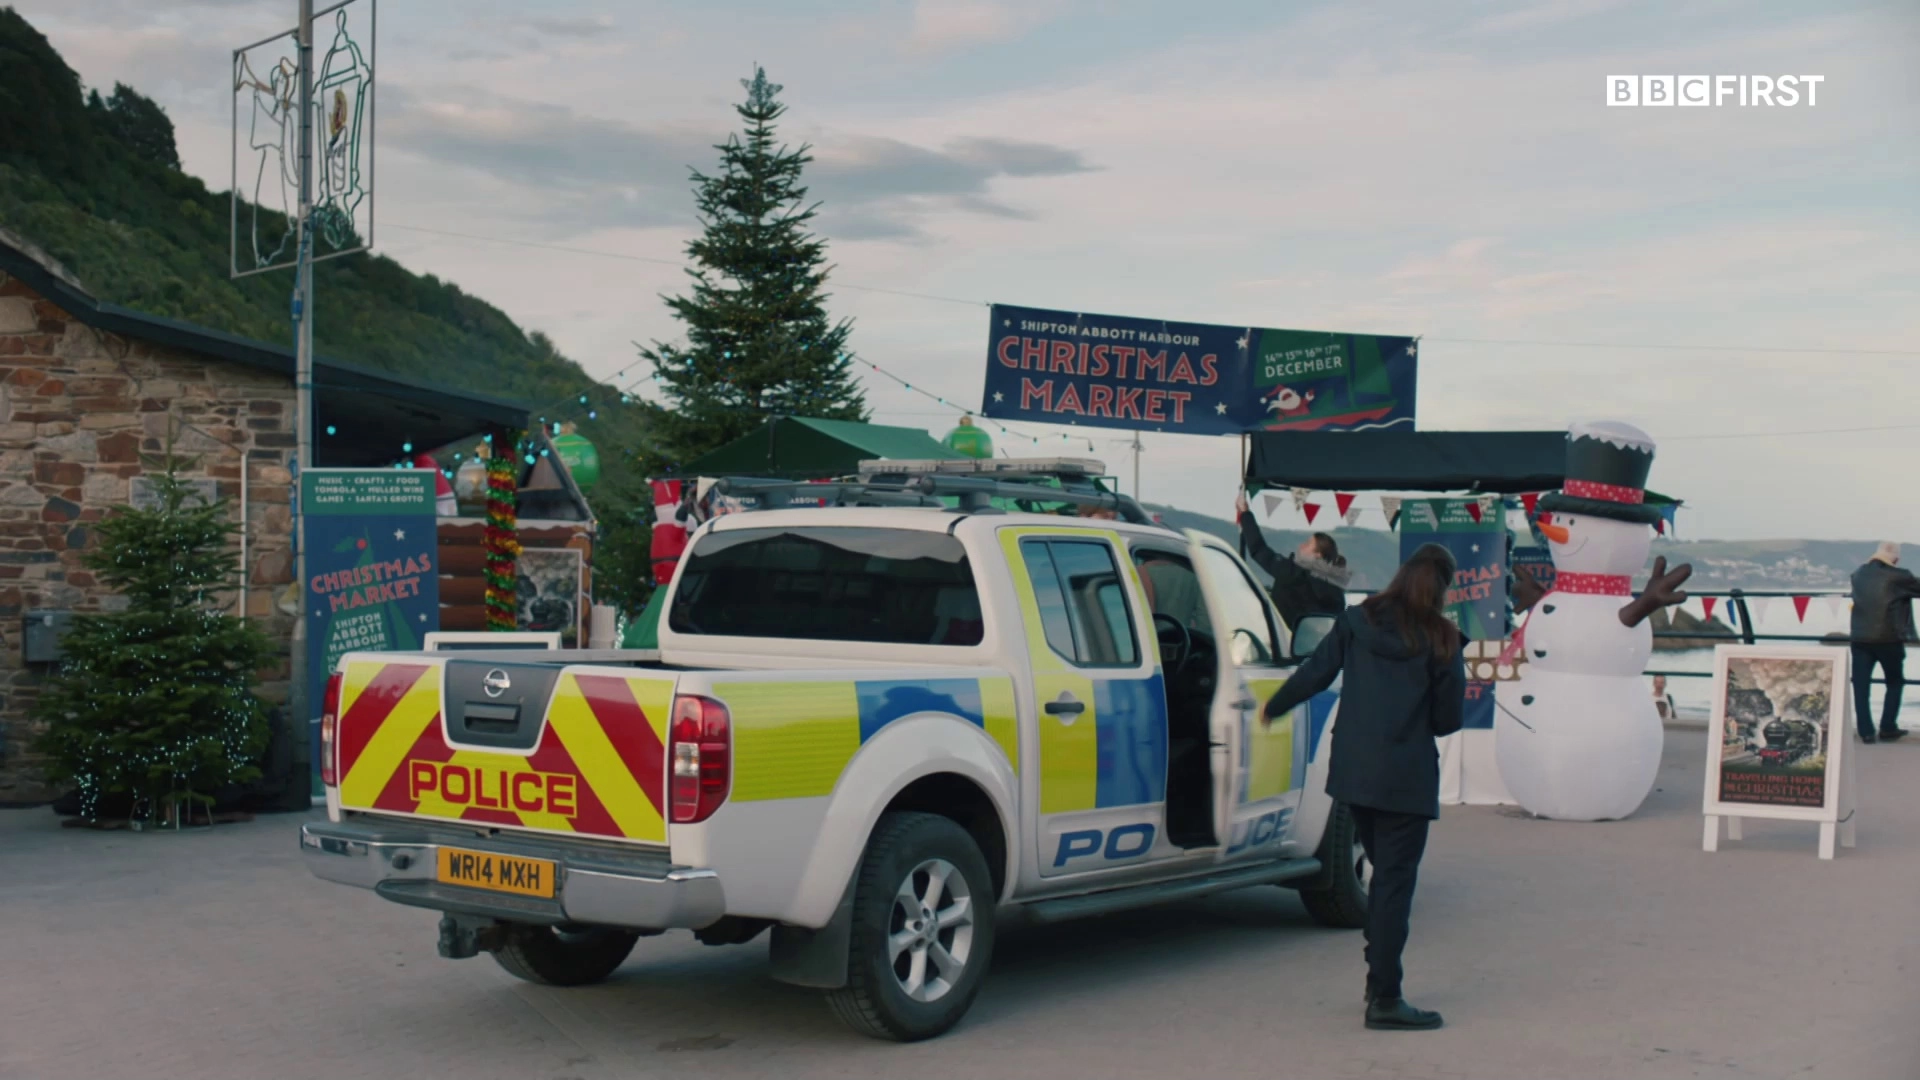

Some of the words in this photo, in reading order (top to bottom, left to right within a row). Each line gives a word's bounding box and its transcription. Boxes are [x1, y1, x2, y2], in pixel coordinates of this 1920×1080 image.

[1020, 320, 1077, 335] SHIPTON
[1081, 327, 1135, 341] ABBOTT
[1139, 332, 1200, 346] HARBOUR
[997, 335, 1218, 386] CHRISTMAS
[1265, 356, 1342, 378] DECEMBER
[1020, 377, 1191, 423] MARKET
[311, 553, 431, 594] CHRISTMAS
[328, 576, 420, 612] MARKET
[1447, 582, 1491, 604] RKET
[332, 622, 382, 641] ABBOTT
[335, 612, 381, 629] SHIPTON
[329, 633, 385, 652] HARBOUR
[411, 761, 575, 816] POLICE
[450, 852, 493, 883] WR14
[500, 859, 540, 890] MXH
